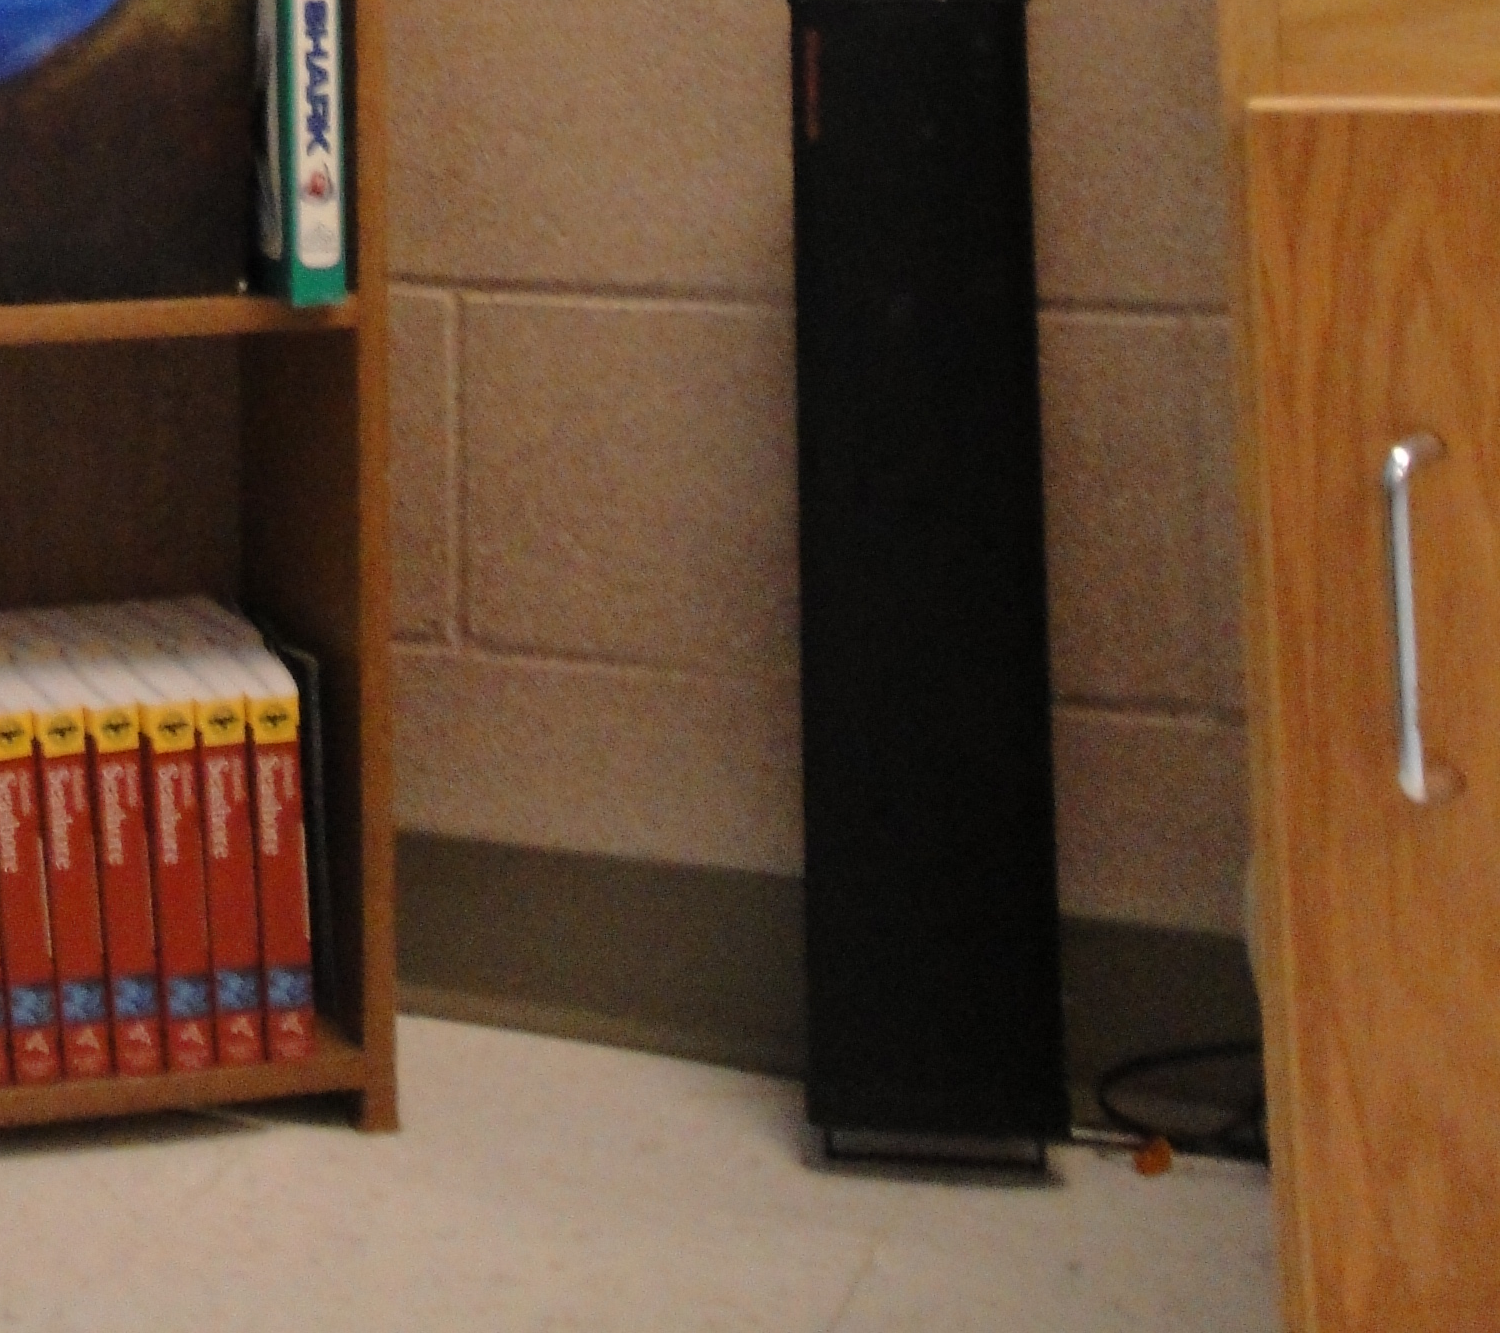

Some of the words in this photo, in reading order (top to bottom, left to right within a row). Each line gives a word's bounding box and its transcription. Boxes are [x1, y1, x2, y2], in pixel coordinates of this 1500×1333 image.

[304, 0, 331, 156] SHARK
[48, 767, 73, 870] Seashore
[101, 763, 127, 865] Seashore
[157, 763, 182, 865] Seashore
[205, 756, 231, 859] Seashore
[257, 755, 282, 857] Seashore
